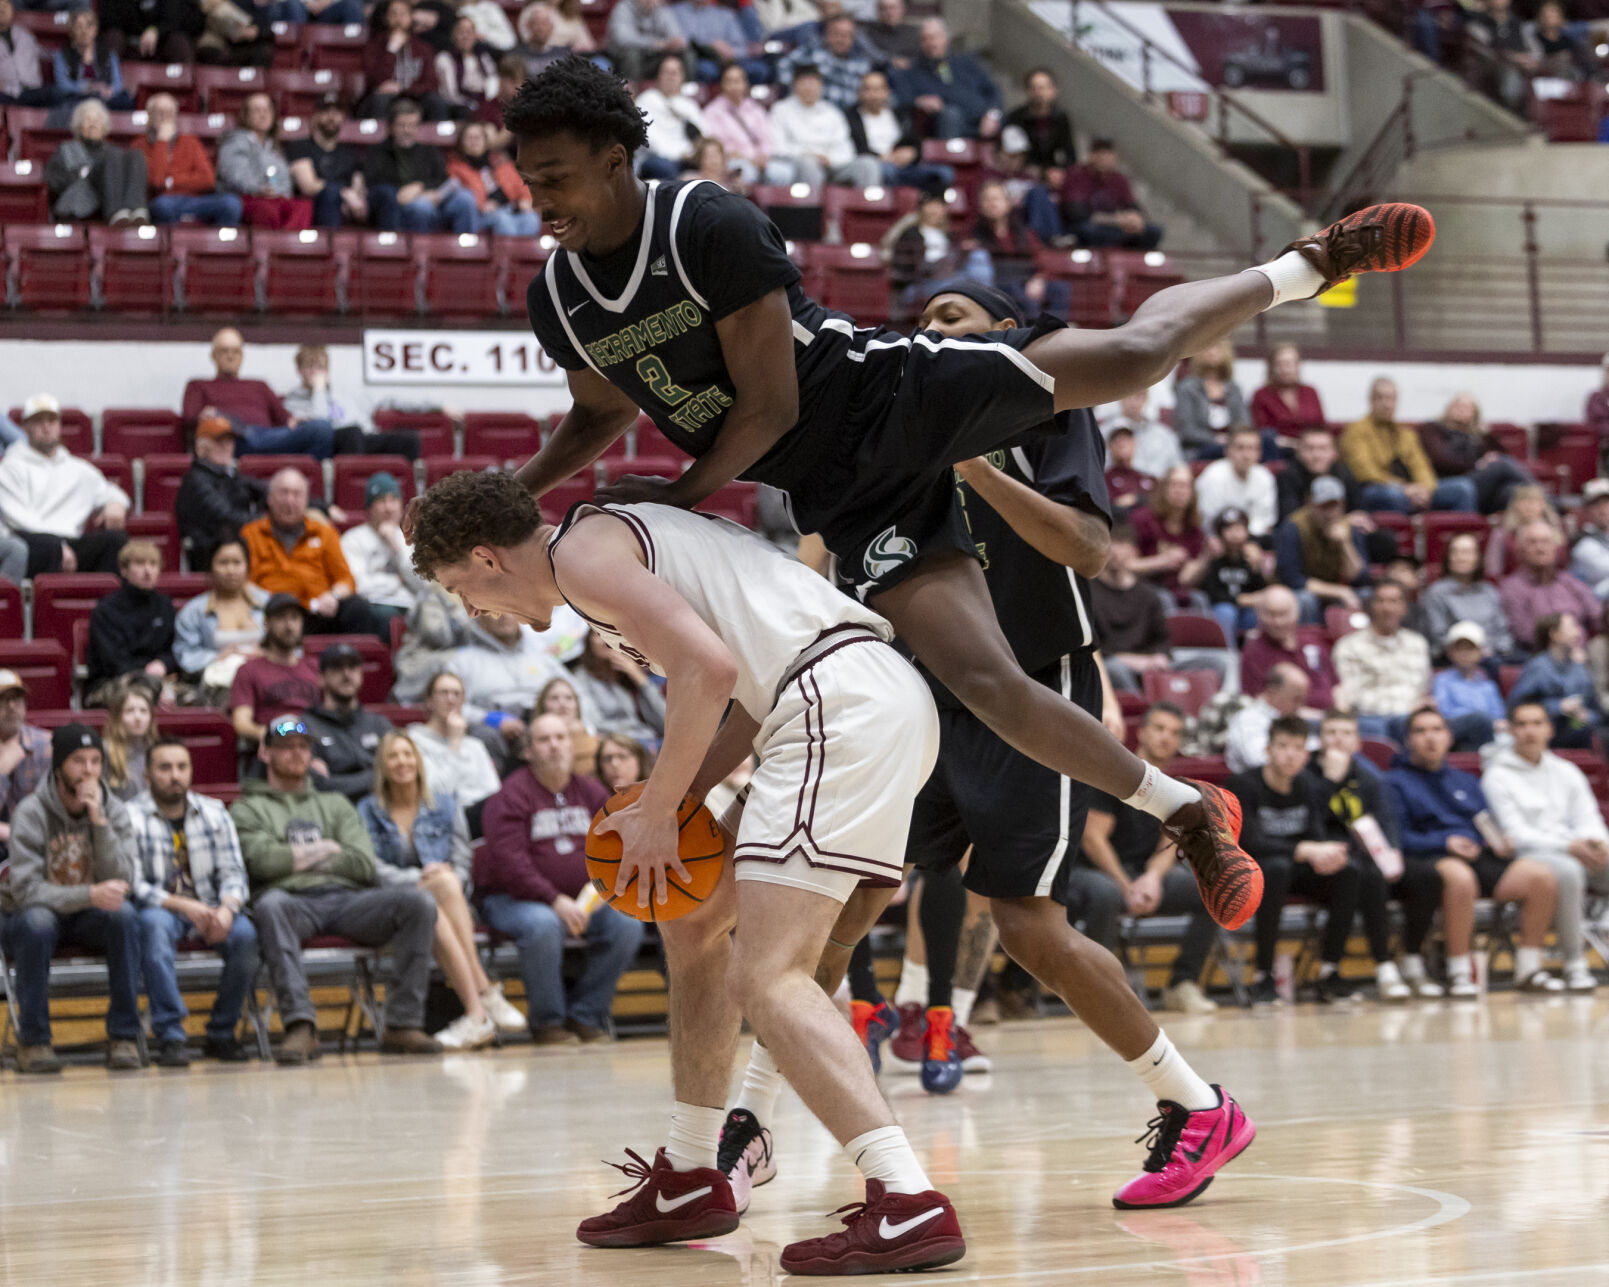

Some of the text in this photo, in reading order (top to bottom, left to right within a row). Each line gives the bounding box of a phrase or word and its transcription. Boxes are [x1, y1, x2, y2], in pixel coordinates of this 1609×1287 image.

[373, 341, 557, 373] SEC. 110
[636, 353, 693, 407] 2
